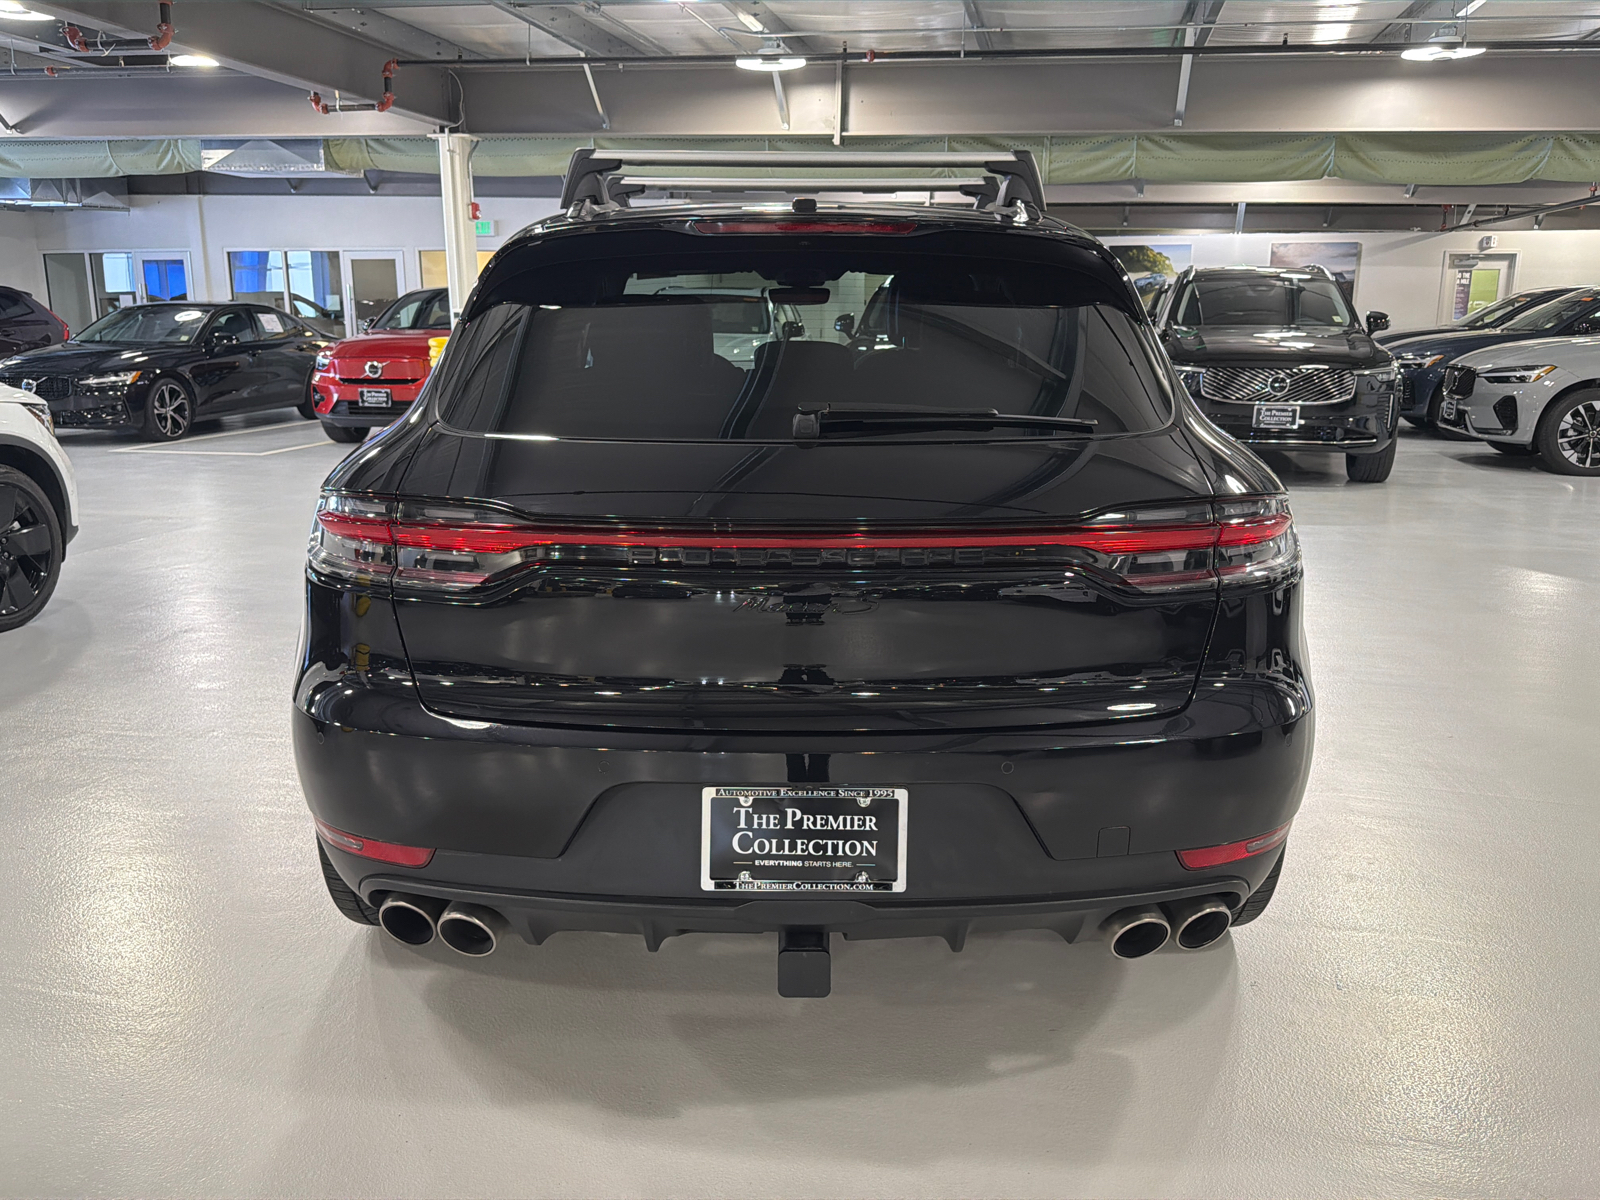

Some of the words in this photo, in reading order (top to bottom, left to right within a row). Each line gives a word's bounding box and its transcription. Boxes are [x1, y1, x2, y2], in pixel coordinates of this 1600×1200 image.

[717, 788, 778, 797] AUTOMOTIVE
[780, 788, 837, 798] EXCELLENCE
[838, 788, 866, 798] SINCE
[868, 789, 894, 798] 1995
[733, 807, 780, 829] THE
[784, 808, 878, 831] PREMIER
[731, 831, 878, 857] COLLECTION
[754, 859, 803, 867] EVERYTHING
[804, 860, 831, 868] STARTS
